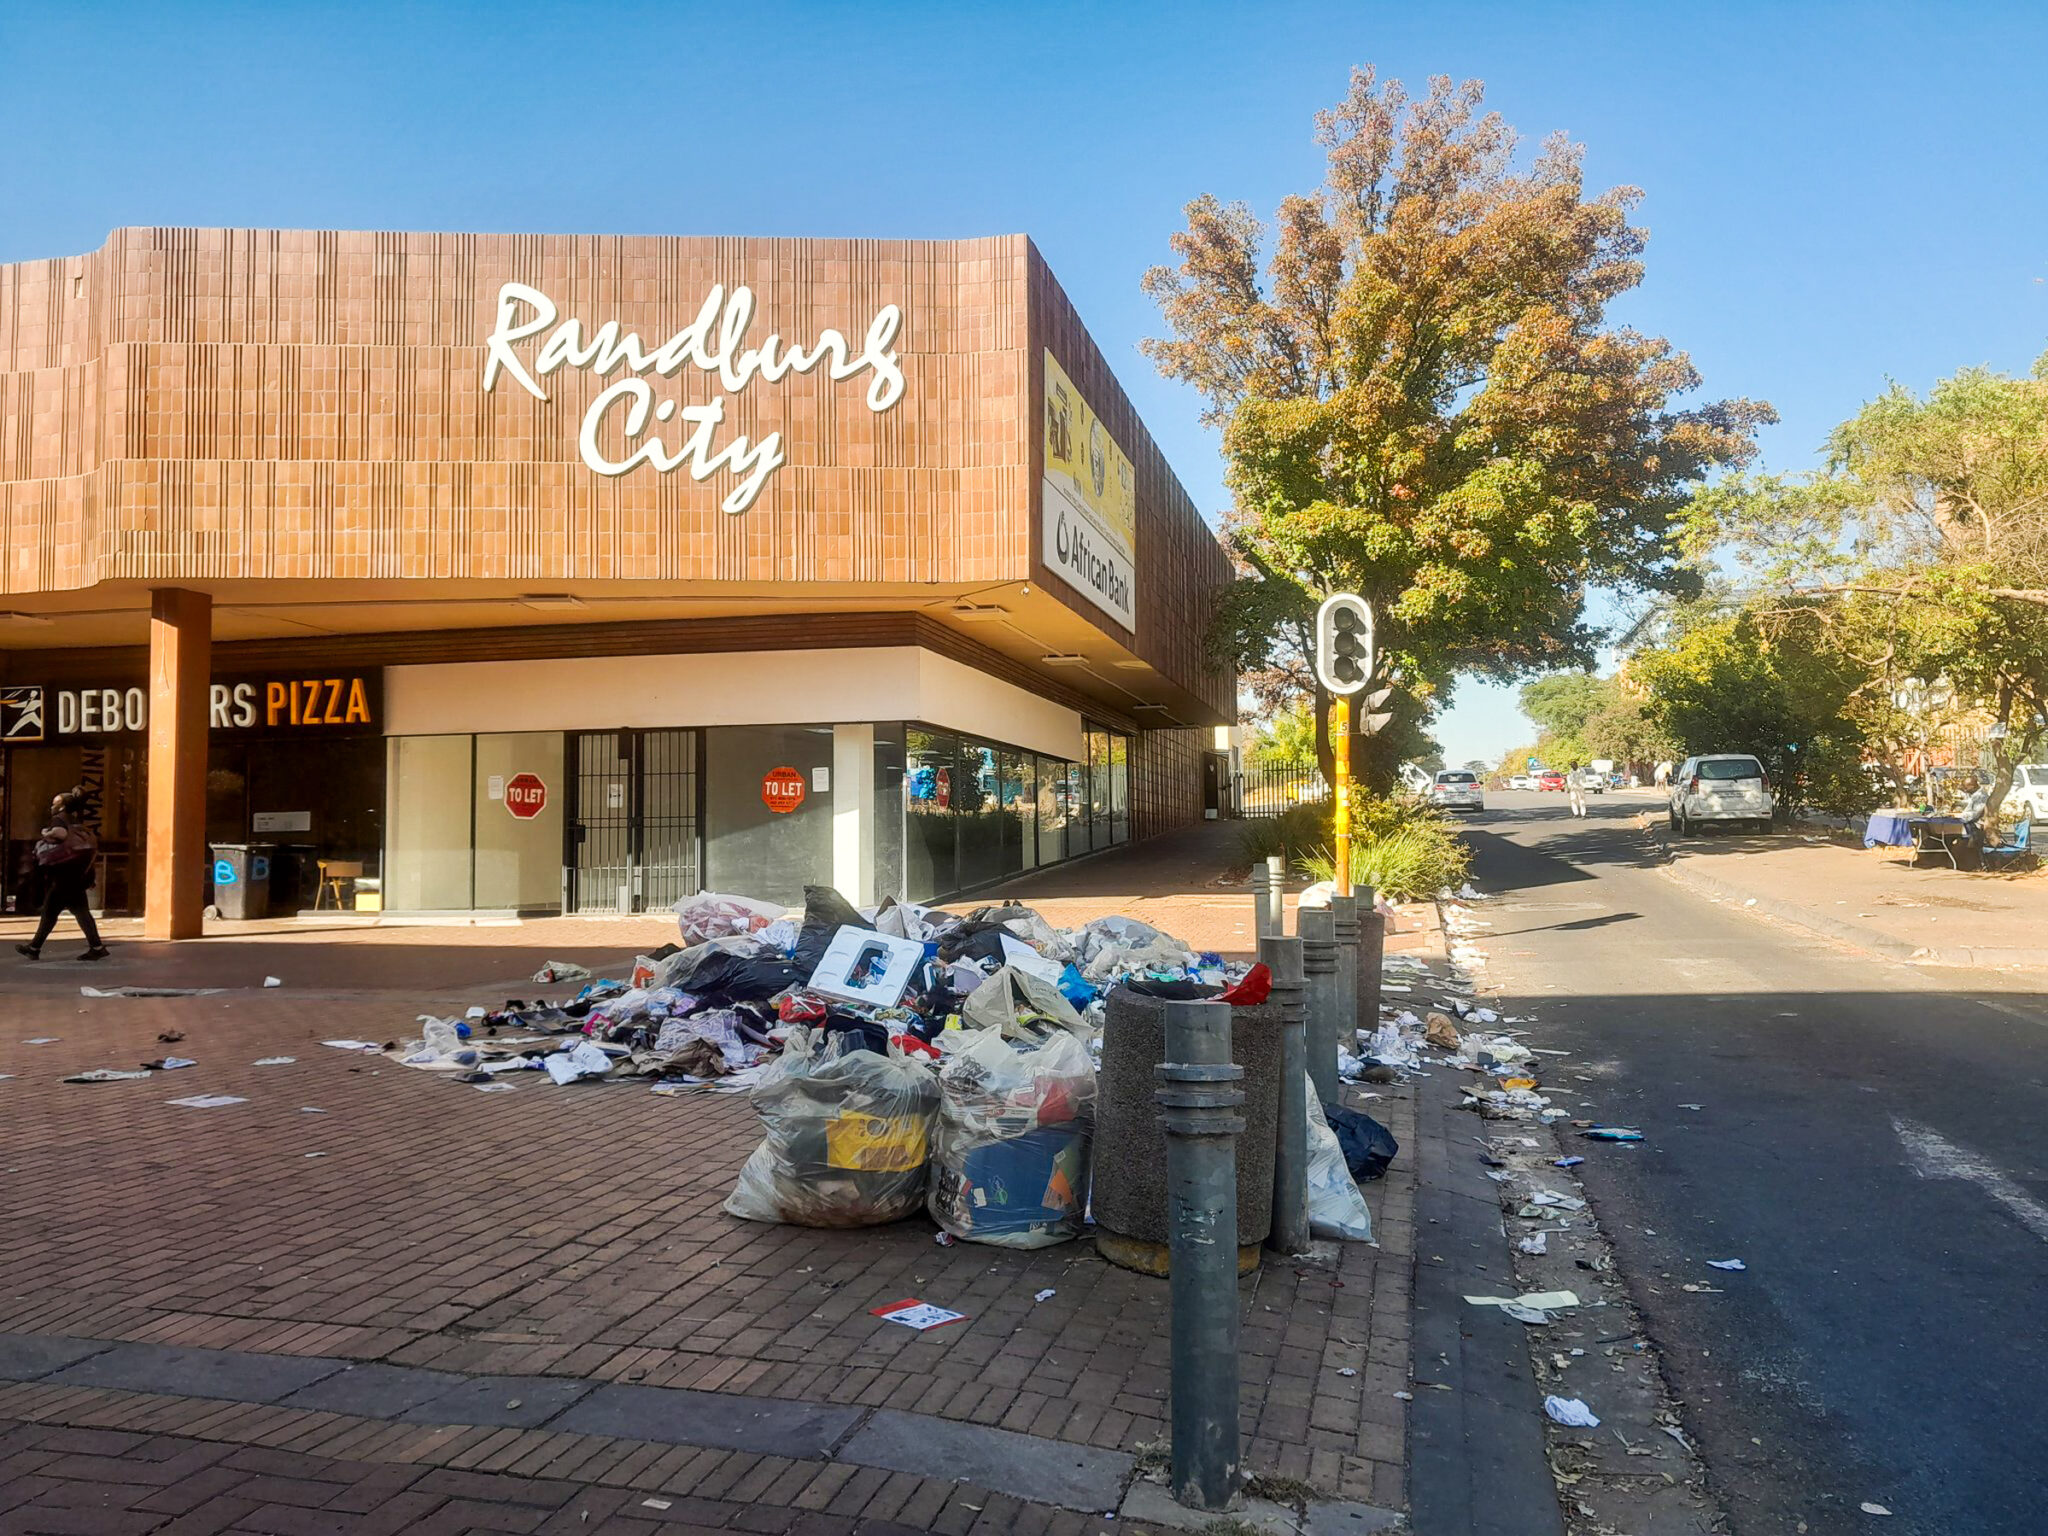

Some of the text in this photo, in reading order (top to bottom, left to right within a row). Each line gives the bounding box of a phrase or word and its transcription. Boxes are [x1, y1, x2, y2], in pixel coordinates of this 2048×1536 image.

[483, 282, 906, 412] Randburg
[579, 377, 785, 514] City
[58, 678, 371, 733] DEBORS PIZZA
[509, 788, 543, 803] TO LET
[765, 782, 802, 796] TO LET
[214, 860, 238, 884] B
[251, 856, 269, 881] B
